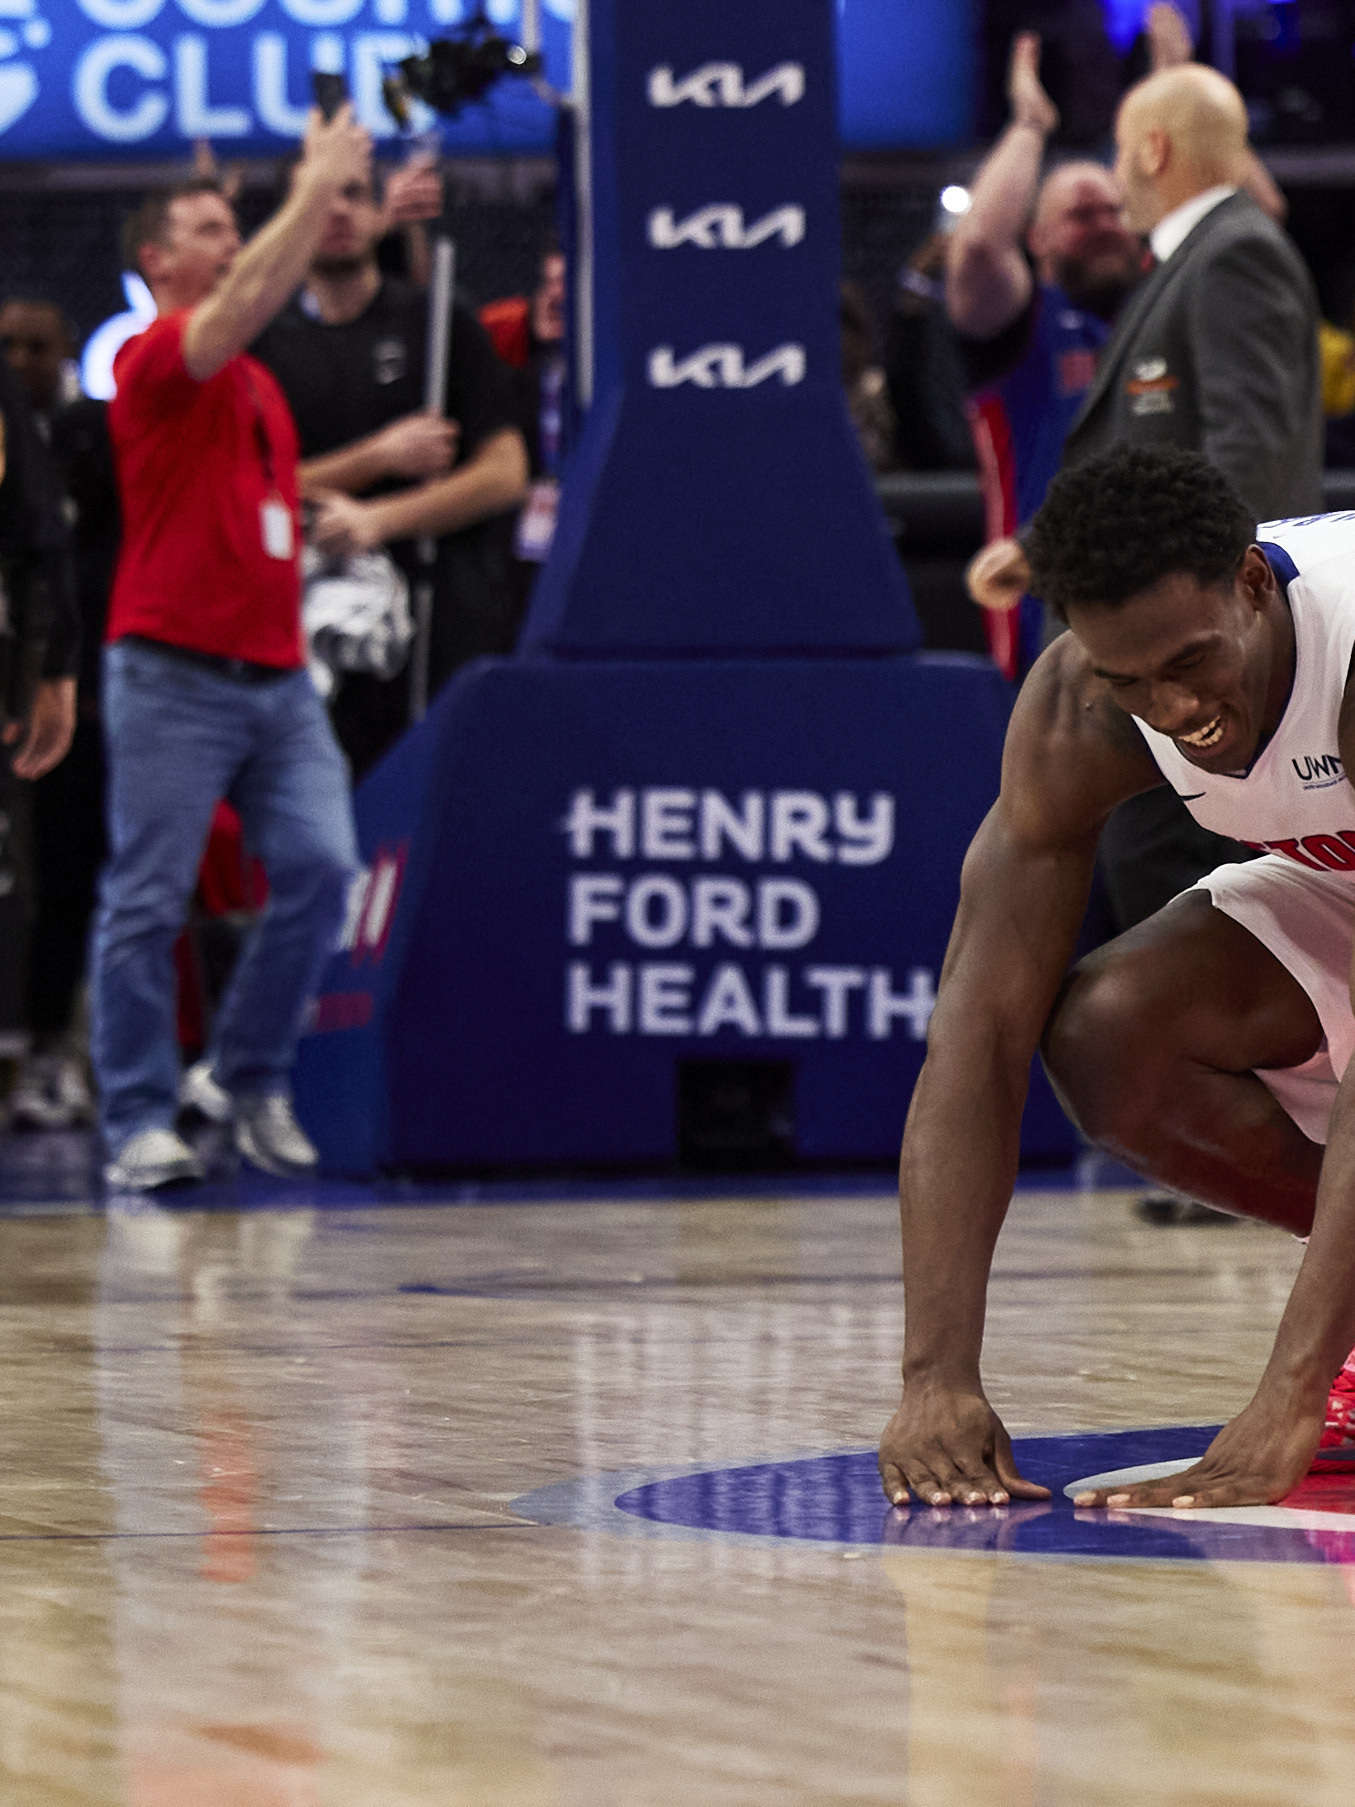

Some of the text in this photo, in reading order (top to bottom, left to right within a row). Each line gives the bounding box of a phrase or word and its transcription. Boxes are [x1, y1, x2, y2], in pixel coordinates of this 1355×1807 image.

[562, 787, 895, 866] HENRY
[569, 874, 820, 949] FORD
[569, 963, 936, 1040] HEALTH
